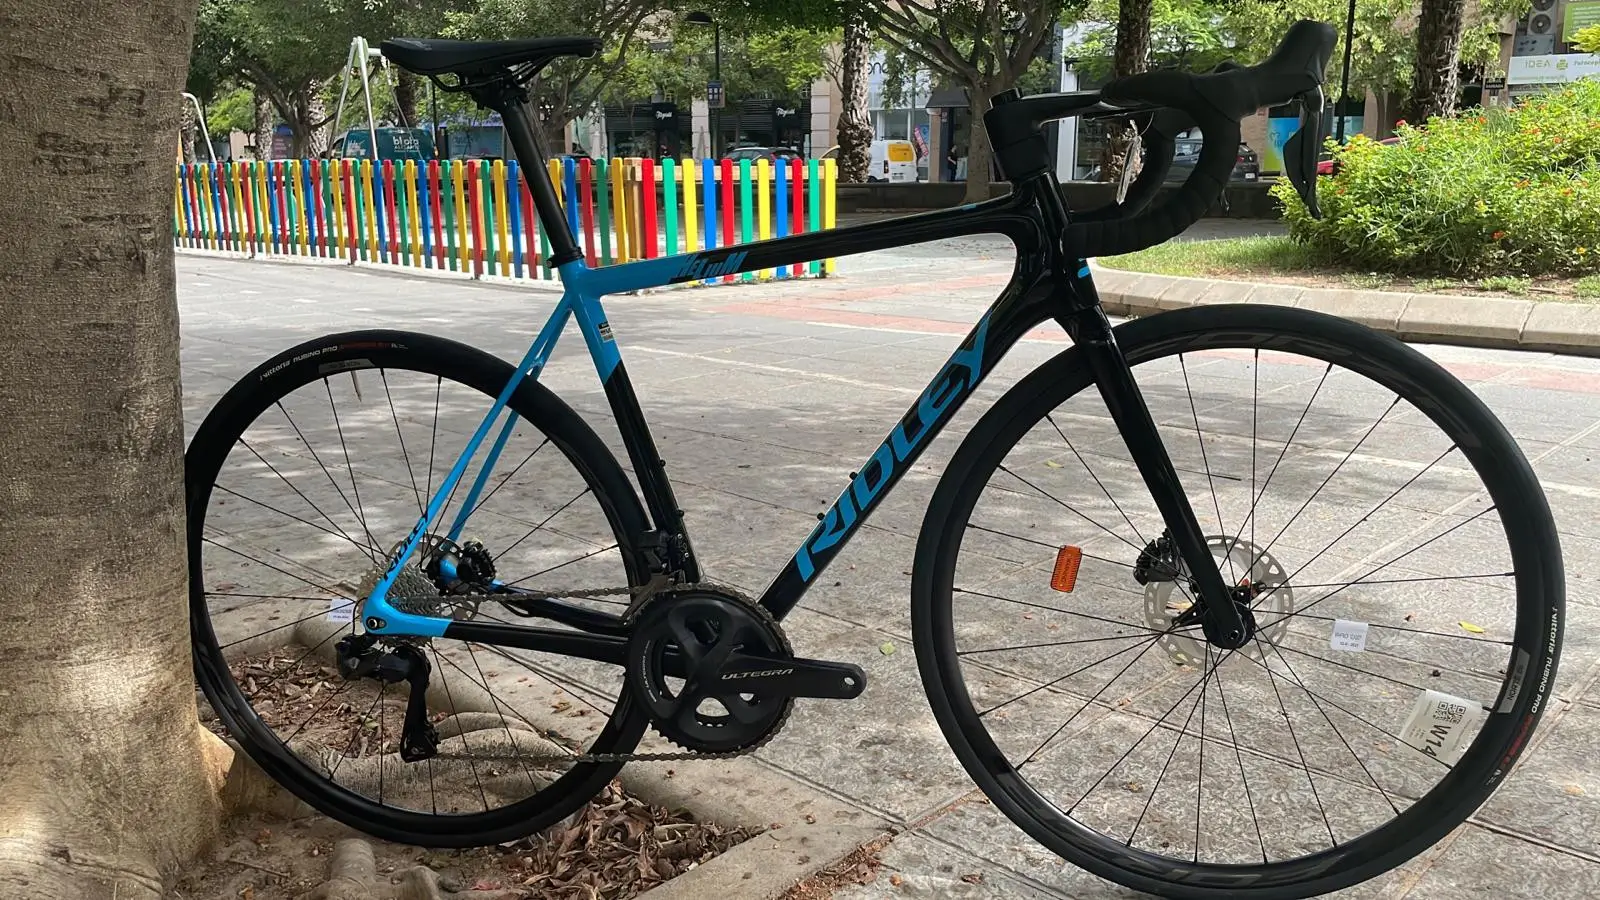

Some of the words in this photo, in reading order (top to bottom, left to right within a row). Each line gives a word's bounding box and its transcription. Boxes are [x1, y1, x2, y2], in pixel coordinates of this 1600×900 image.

[322, 345, 338, 353] PRO
[795, 308, 993, 583] RIDLEY
[383, 507, 428, 582] RIDLEY
[1548, 613, 1559, 656] vittoria
[721, 668, 795, 680] ULTEGRA
[1538, 657, 1552, 693] RUBINO
[1531, 693, 1543, 714] PRO
[1421, 724, 1452, 757] W14
